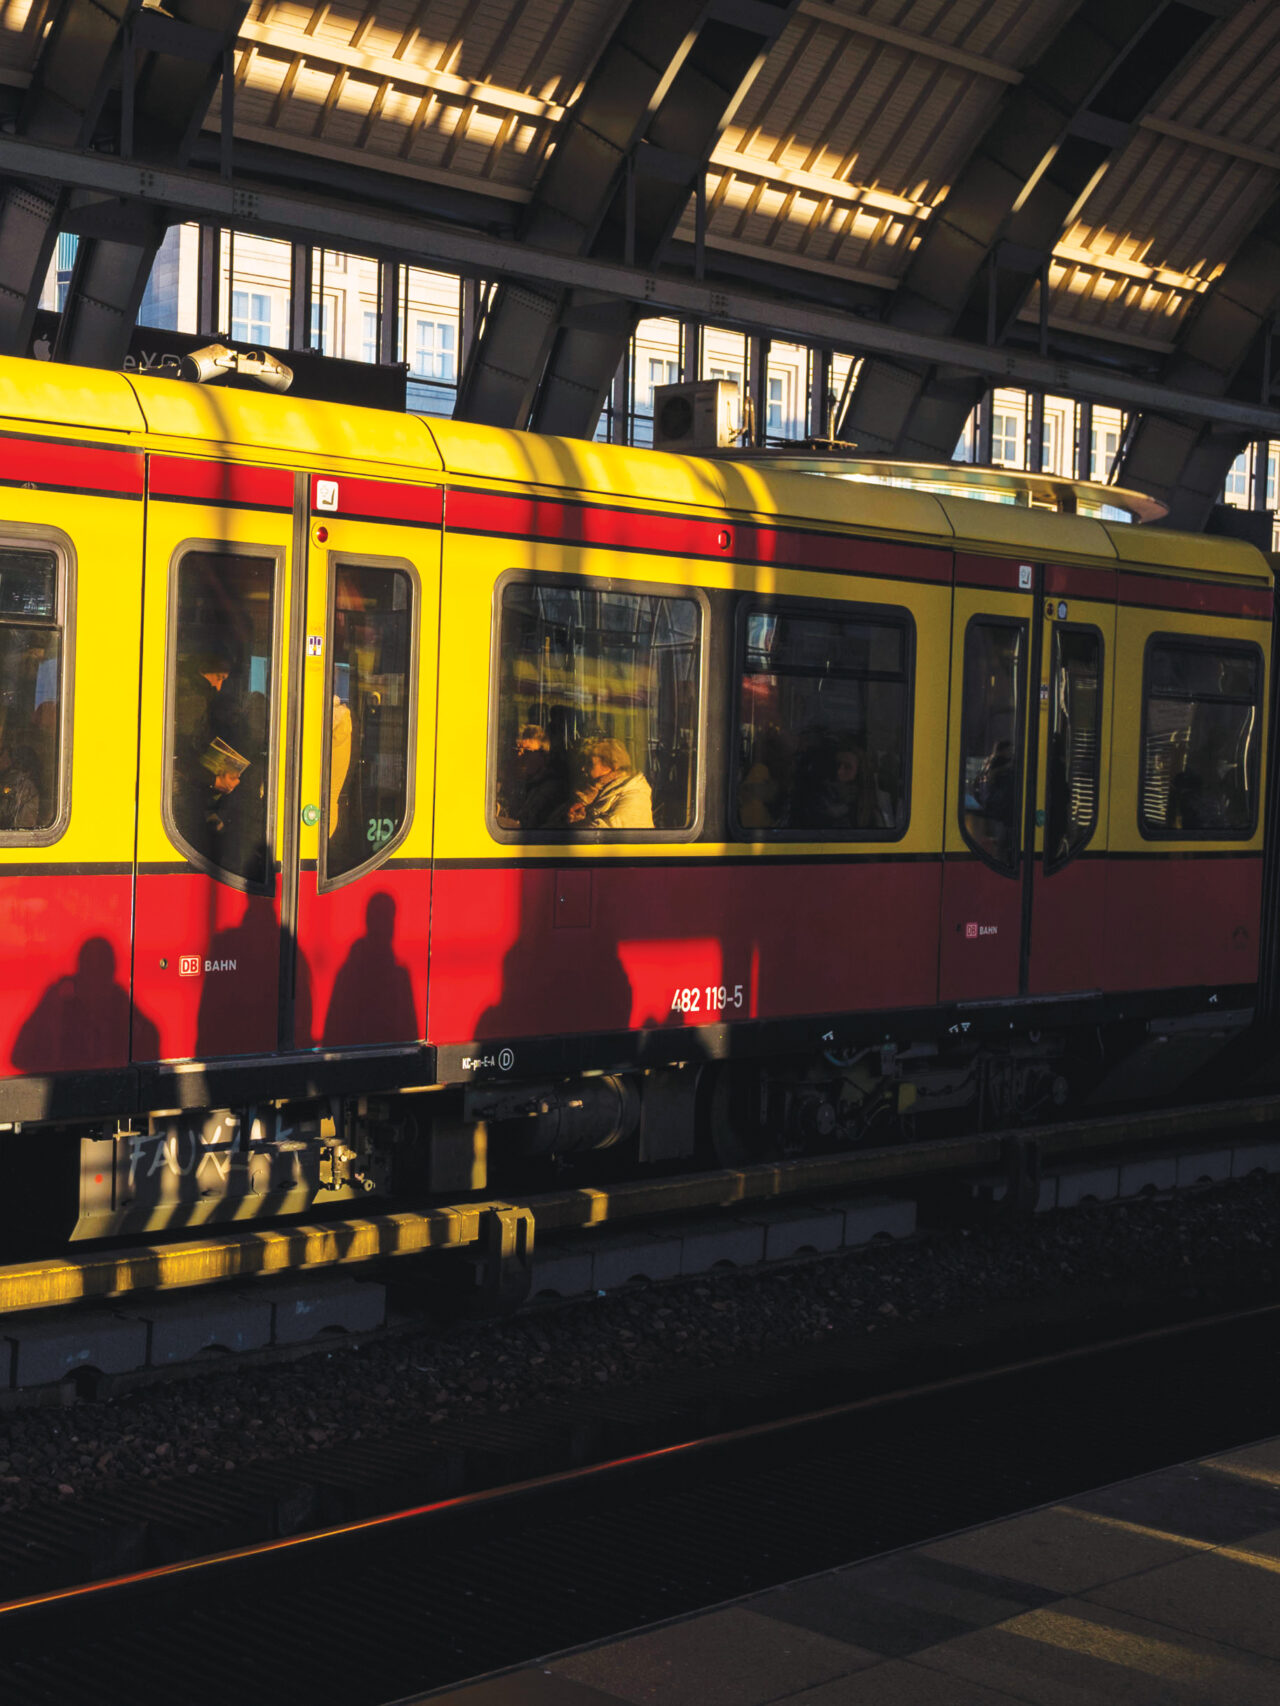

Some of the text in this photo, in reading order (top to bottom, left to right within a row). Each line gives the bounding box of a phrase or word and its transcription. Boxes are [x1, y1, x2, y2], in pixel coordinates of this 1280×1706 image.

[979, 926, 998, 935] BAHN
[204, 959, 237, 972] BAHN
[671, 984, 743, 1013] 482 119-5
